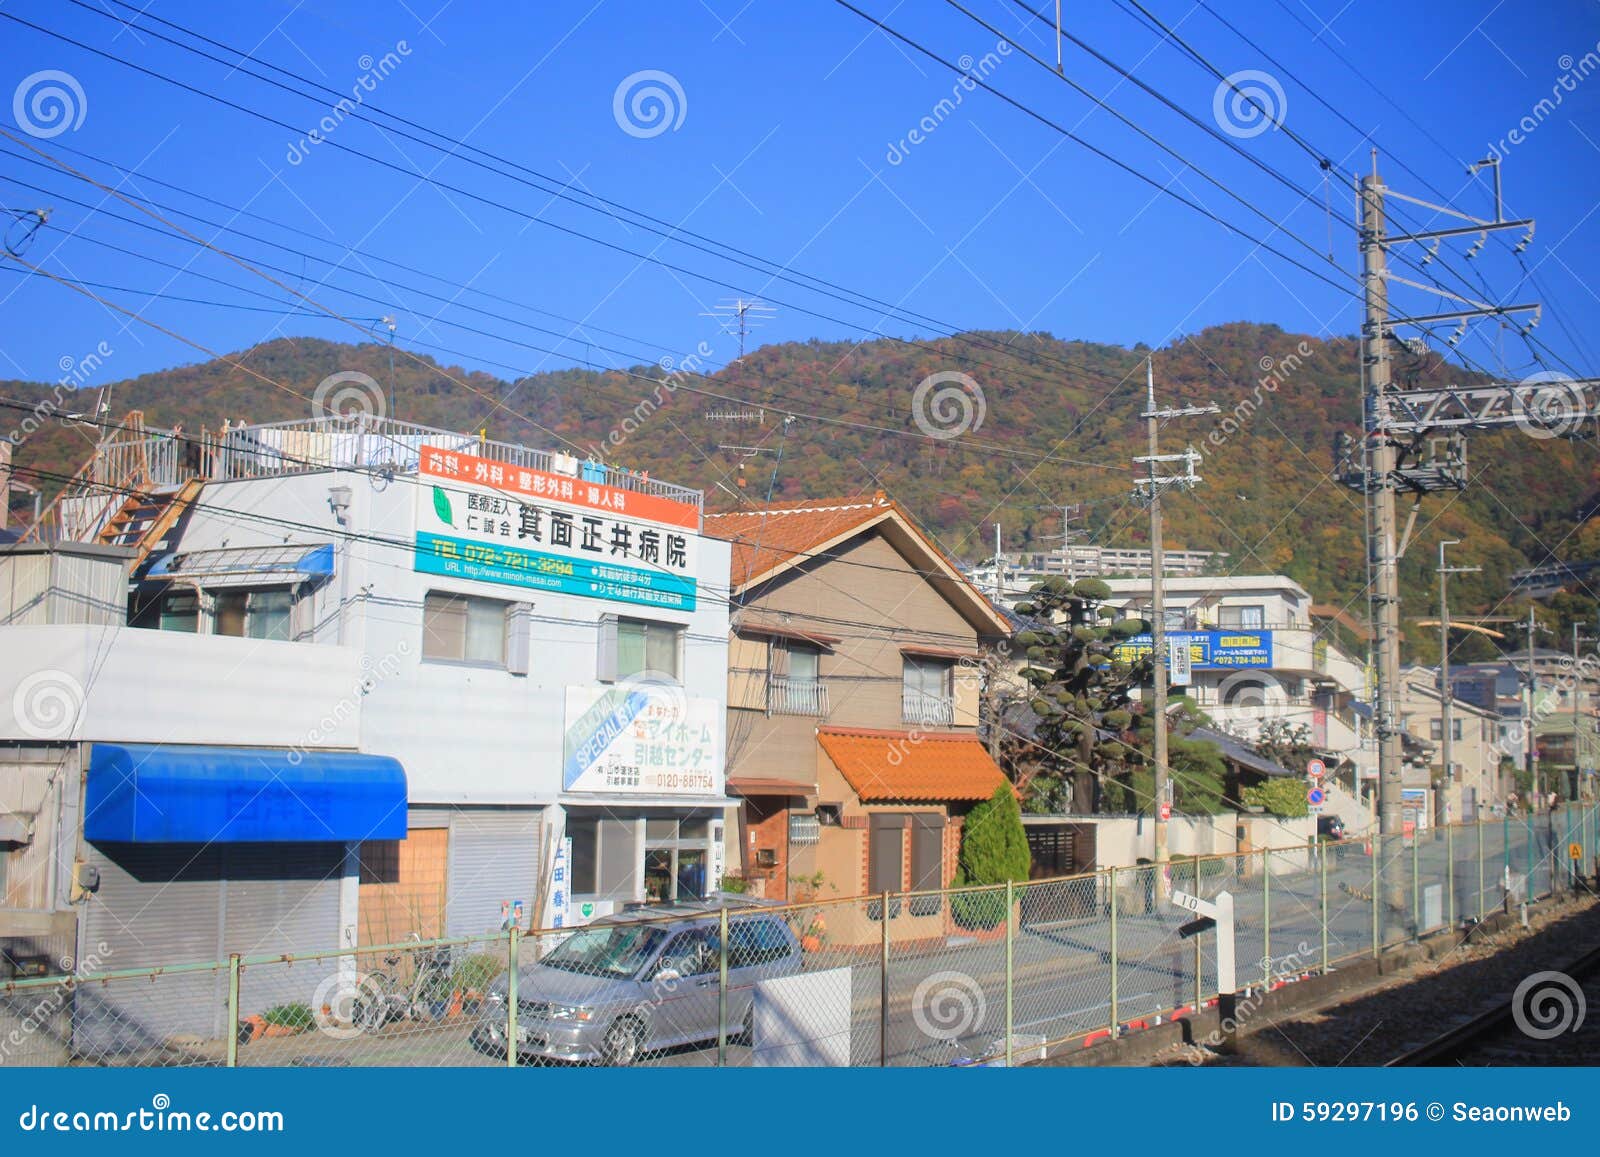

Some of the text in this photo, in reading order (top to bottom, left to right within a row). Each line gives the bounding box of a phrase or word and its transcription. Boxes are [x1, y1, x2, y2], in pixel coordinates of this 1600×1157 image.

[467, 495, 511, 517] 医療法人
[467, 515, 511, 537] 仁誠会
[518, 504, 687, 568] 箕面正井病院
[432, 539, 461, 559] TEL
[444, 561, 461, 573] URL
[634, 744, 713, 767] 引越センター
[1180, 894, 1199, 911] 10
